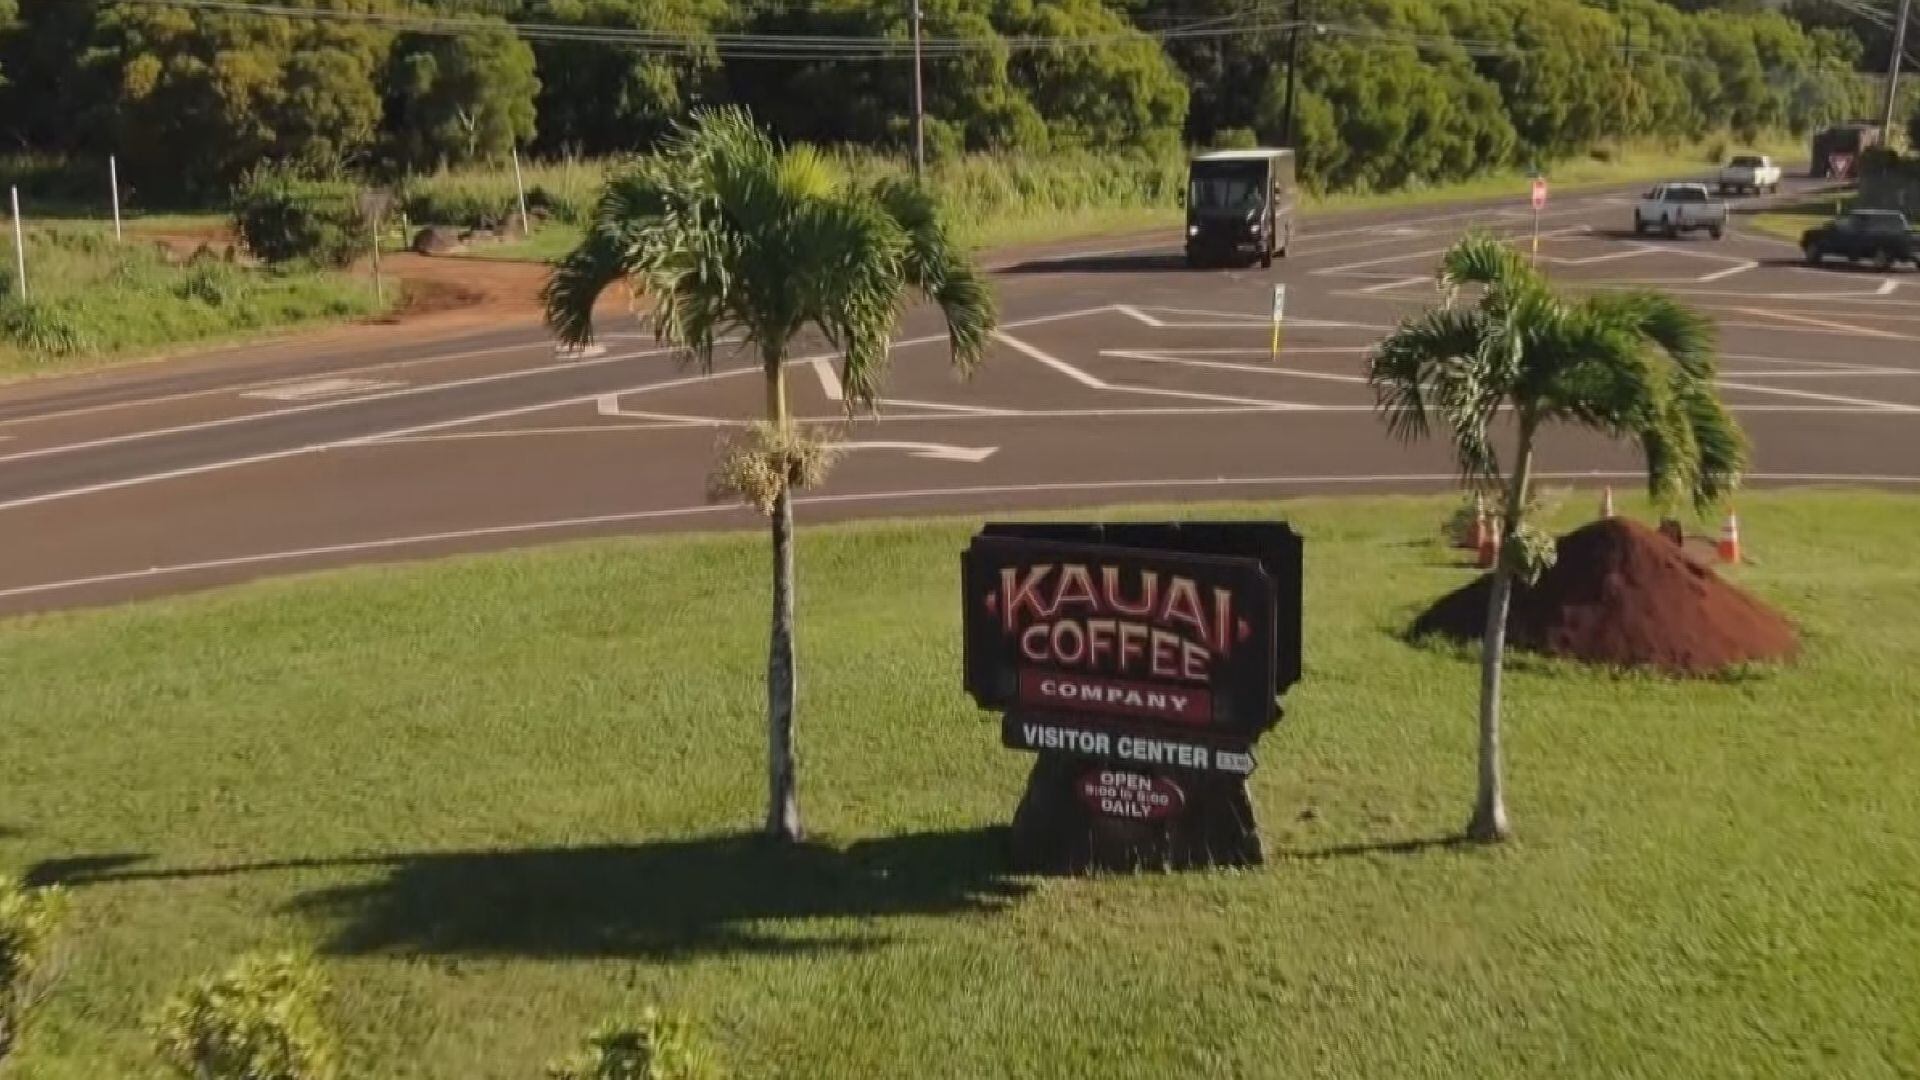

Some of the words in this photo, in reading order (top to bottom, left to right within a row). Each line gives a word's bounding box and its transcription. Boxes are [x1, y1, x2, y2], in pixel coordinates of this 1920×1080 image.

[1000, 563, 1233, 653] KAUAI
[1022, 619, 1211, 680] COFFEE
[1040, 680, 1188, 711] COMPANY
[1023, 723, 1110, 754] VISITOR
[1117, 736, 1208, 769] CENTER
[1101, 771, 1151, 790] OPEN
[1101, 800, 1151, 817] DAILY
